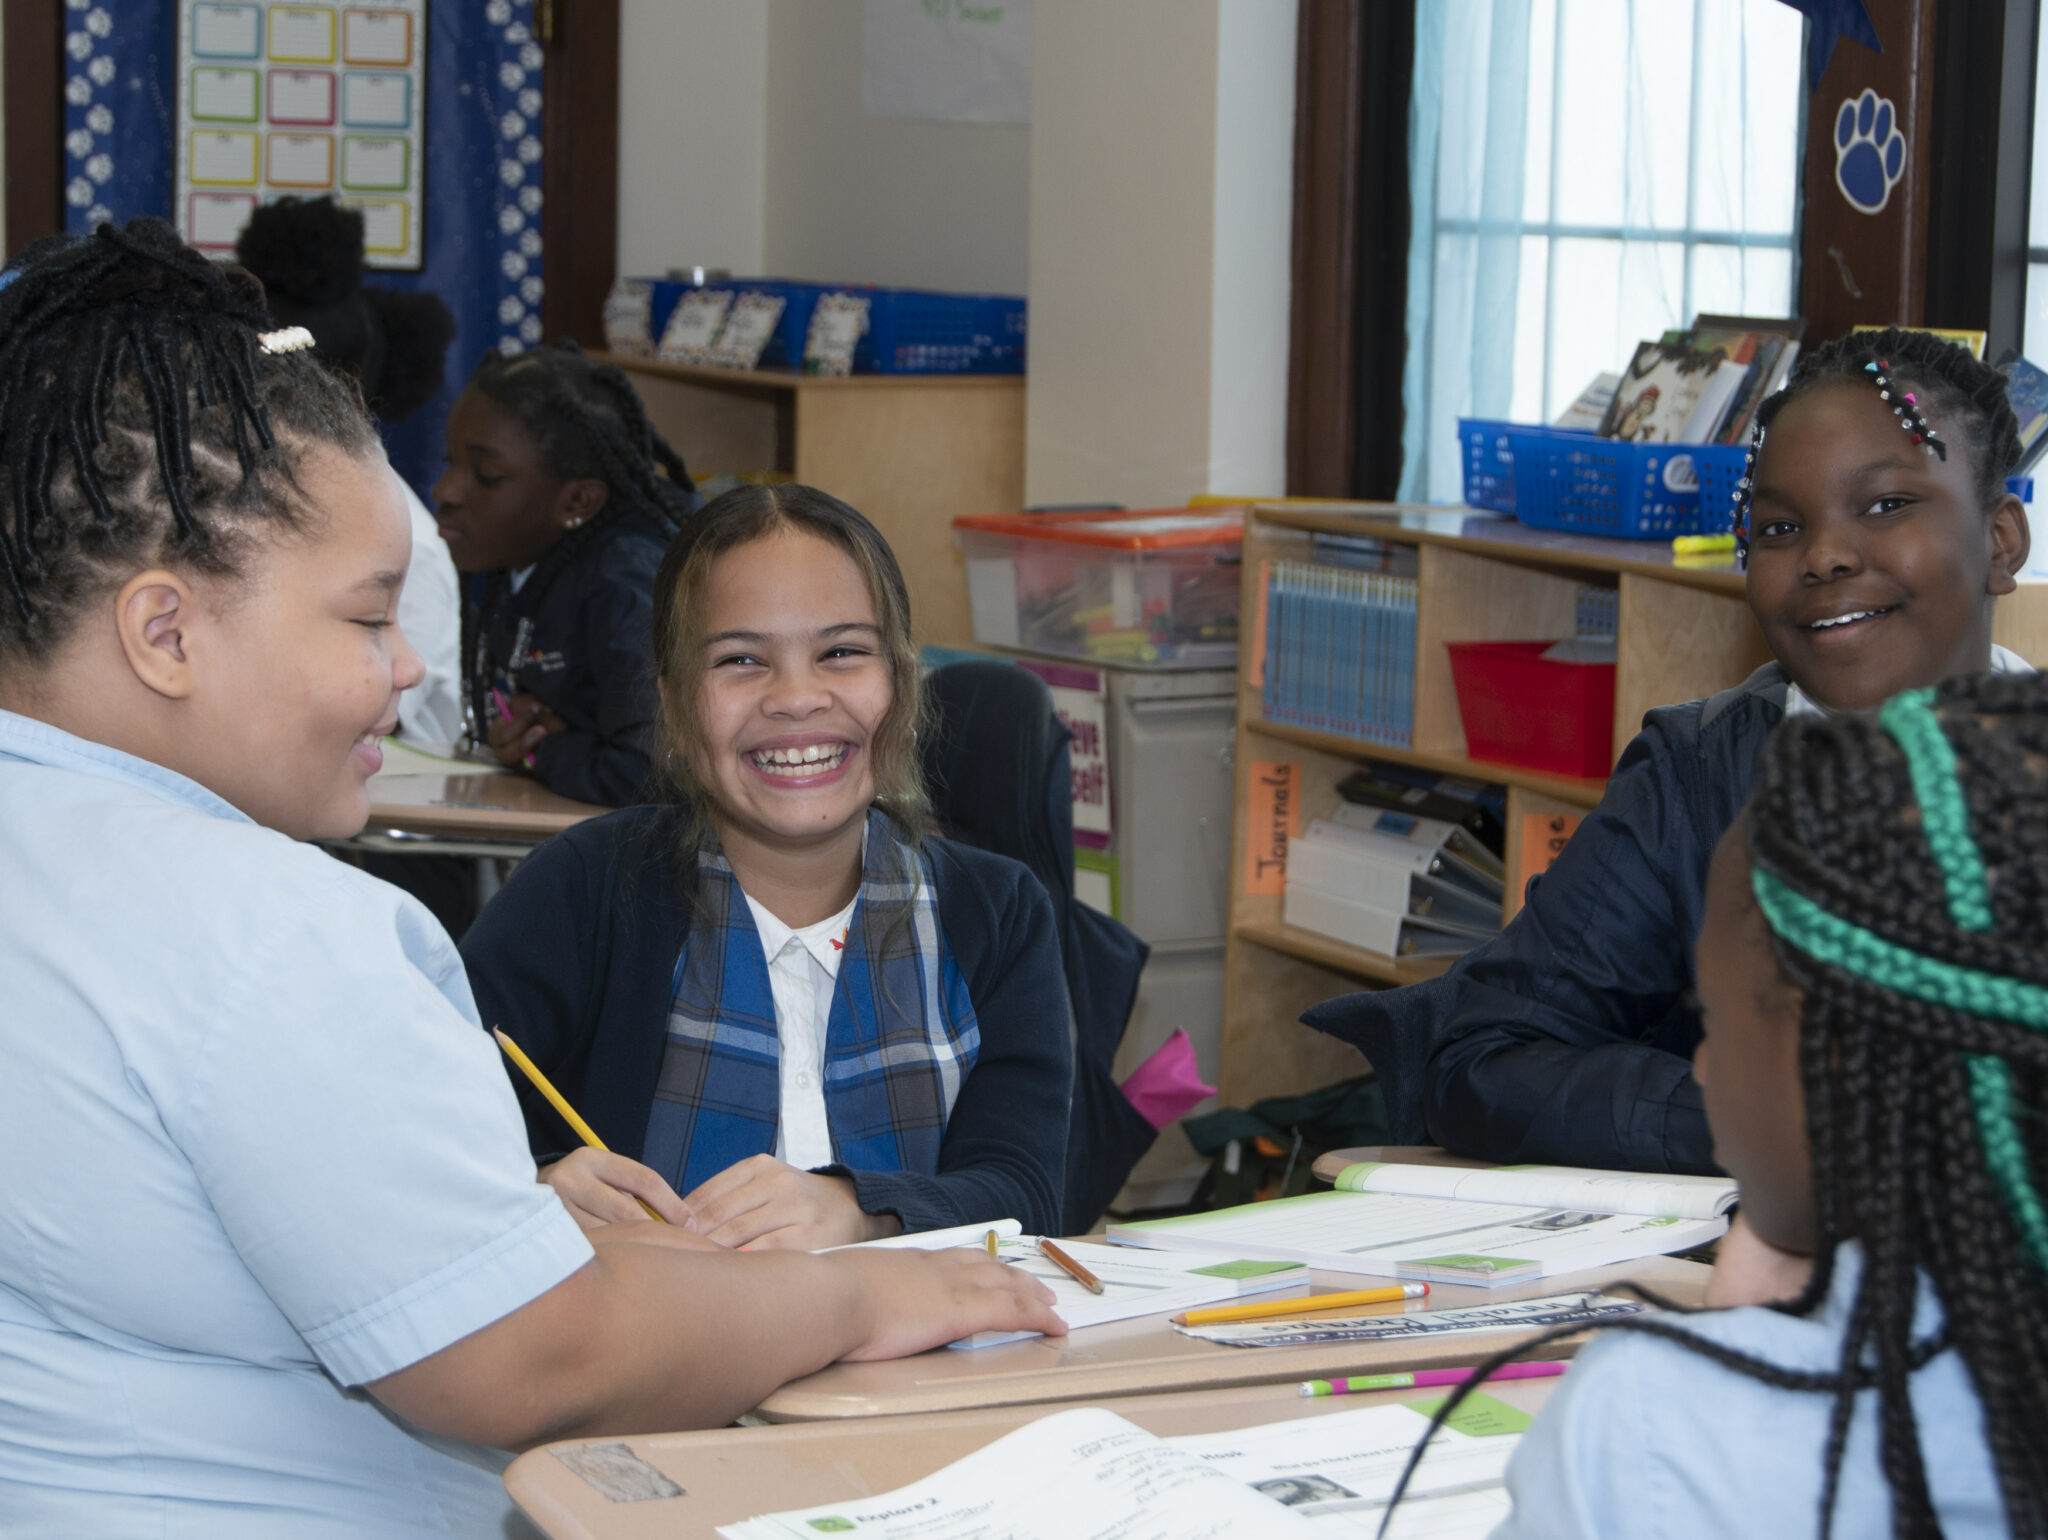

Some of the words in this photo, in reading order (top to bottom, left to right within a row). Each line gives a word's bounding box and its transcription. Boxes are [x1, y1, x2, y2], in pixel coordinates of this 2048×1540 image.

[1255, 764, 1291, 880] Journals
[1433, 1298, 1595, 1323] Annabel
[1200, 1451, 1244, 1460] Hook
[856, 1503, 924, 1522] Explore
[926, 1497, 939, 1505] 2
